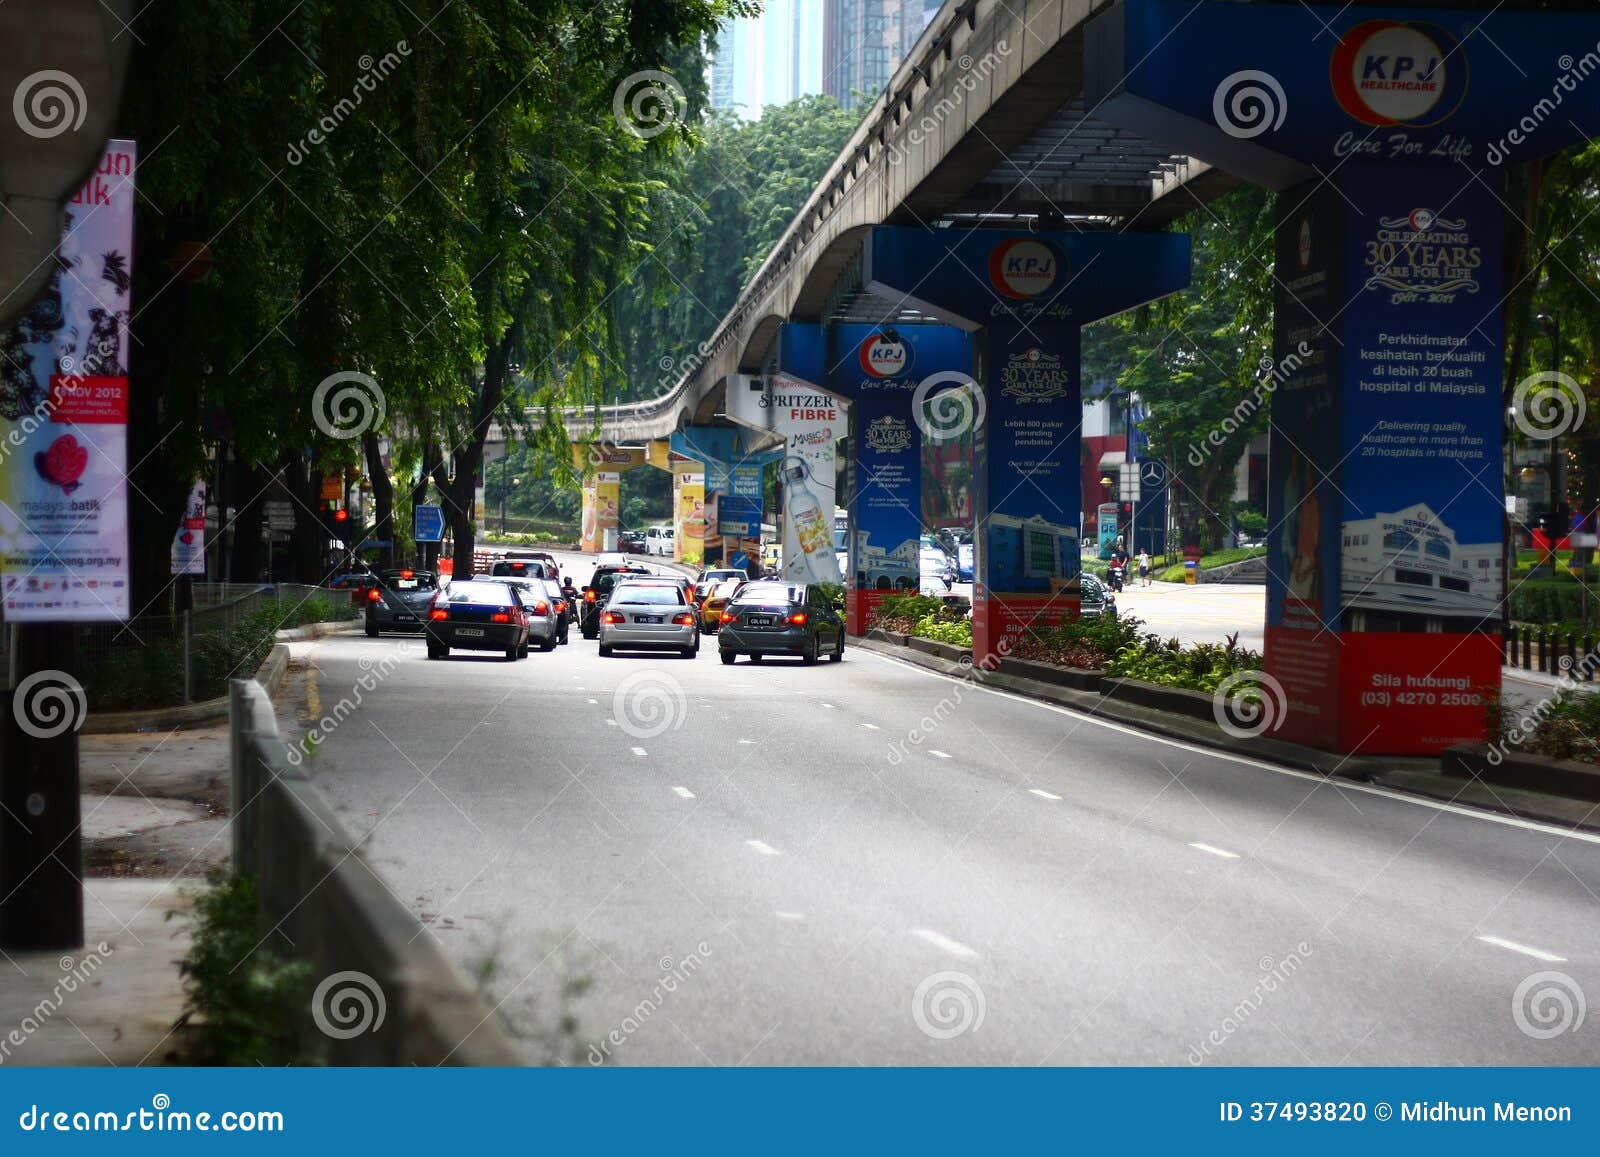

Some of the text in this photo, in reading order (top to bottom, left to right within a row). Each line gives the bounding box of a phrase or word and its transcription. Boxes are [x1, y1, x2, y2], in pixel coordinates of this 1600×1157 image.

[1362, 55, 1437, 81] KPJ
[1360, 80, 1437, 92] HEALTHCARE
[1334, 131, 1472, 162] Care For Life
[96, 152, 131, 176] un
[1376, 229, 1470, 244] CELEBRATING
[1364, 241, 1482, 268] 30 YEARS
[1008, 257, 1052, 272] KPJ
[1413, 266, 1440, 279] FOR
[1378, 333, 1468, 346] Perkhidmatan
[872, 348, 902, 359] KPJ
[1360, 348, 1486, 362] kesihatan berkualiti
[1000, 368, 1069, 383] 30 YEARS
[1373, 365, 1473, 378] di lebih 20 buah
[96, 387, 122, 398] 2012
[1360, 380, 1486, 395] hospital di Malaysia
[759, 393, 834, 408] SPRITZER
[791, 409, 837, 421] FIBRE
[1378, 420, 1467, 433] Delivering quality
[1363, 434, 1484, 445] healthcare in more than
[1362, 447, 1484, 459] 20 hospitals in Malaysia
[1371, 673, 1473, 690] Sila hubungi
[1361, 692, 1391, 707] (03)
[1395, 692, 1437, 706] 4270
